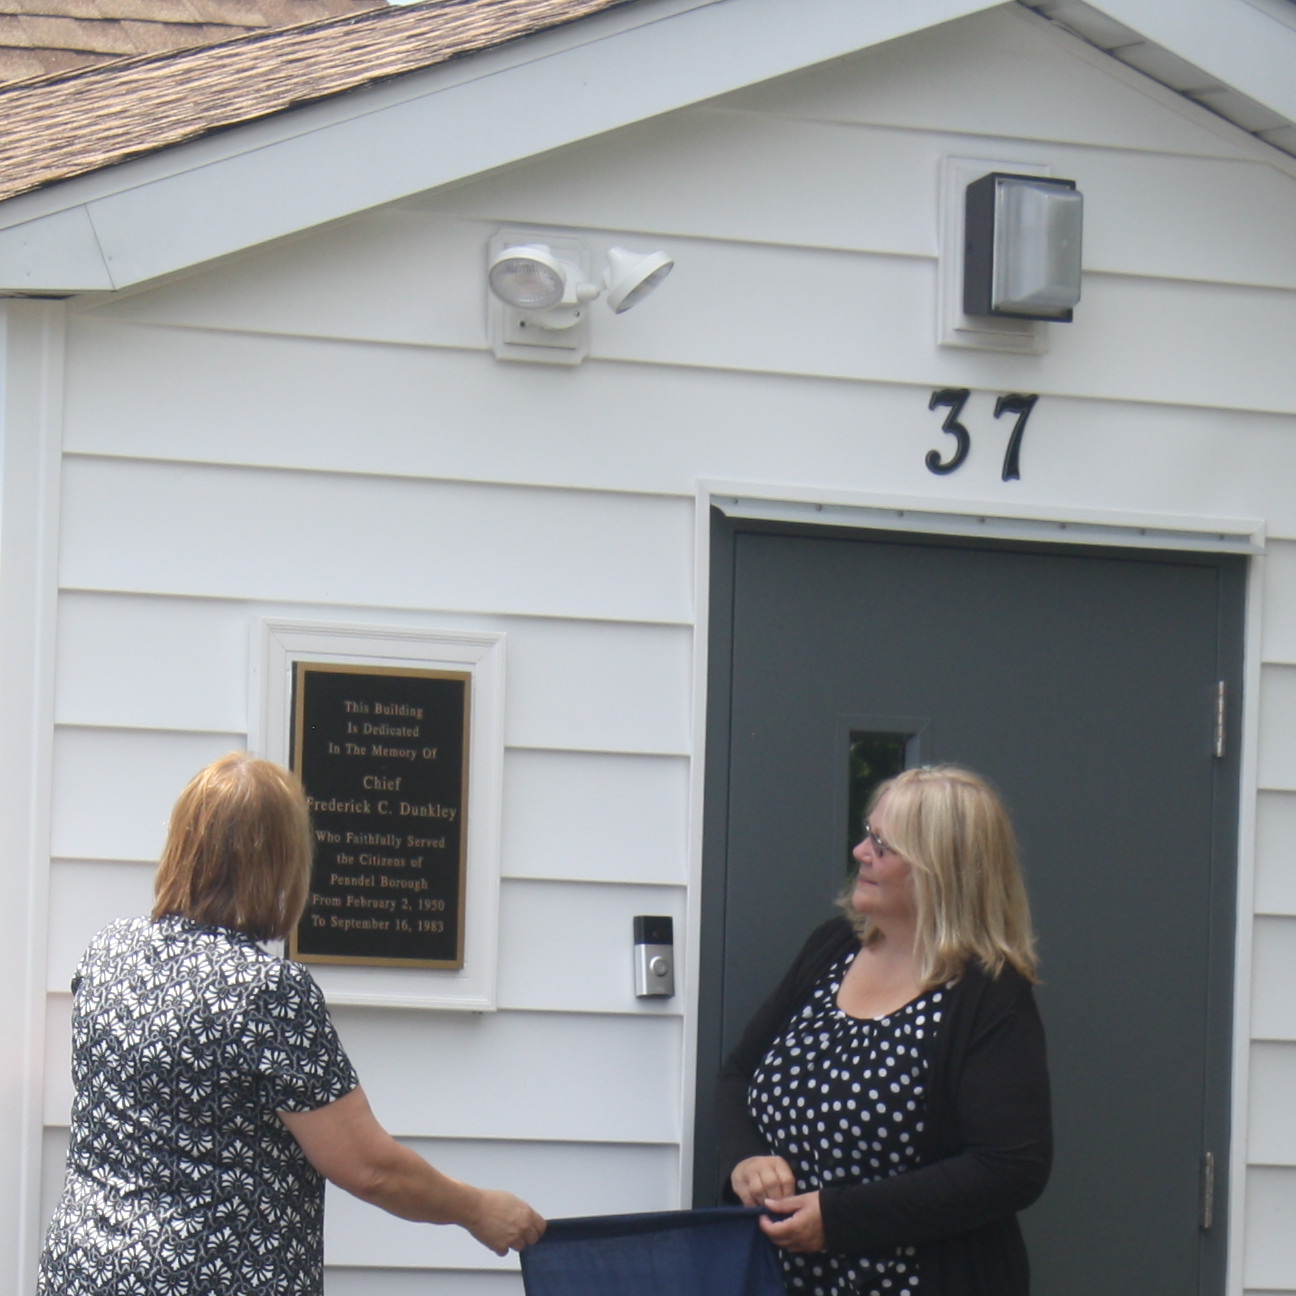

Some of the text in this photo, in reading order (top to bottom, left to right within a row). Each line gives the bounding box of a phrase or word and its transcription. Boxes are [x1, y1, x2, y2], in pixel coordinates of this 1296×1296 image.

[924, 388, 1039, 483] 37
[344, 701, 423, 719] This Building
[347, 722, 420, 737] Is Dedicated
[328, 742, 438, 761] In The Memory Of
[363, 776, 402, 791] Chief
[306, 796, 457, 821] Frederick C. Dunkley
[315, 830, 446, 848] Who Faithfully Served
[336, 853, 424, 868] the Citizens of
[330, 873, 428, 892] Penndel Borough
[312, 894, 445, 912] From February 2, 1950
[311, 915, 444, 933] To September 16, 1983
